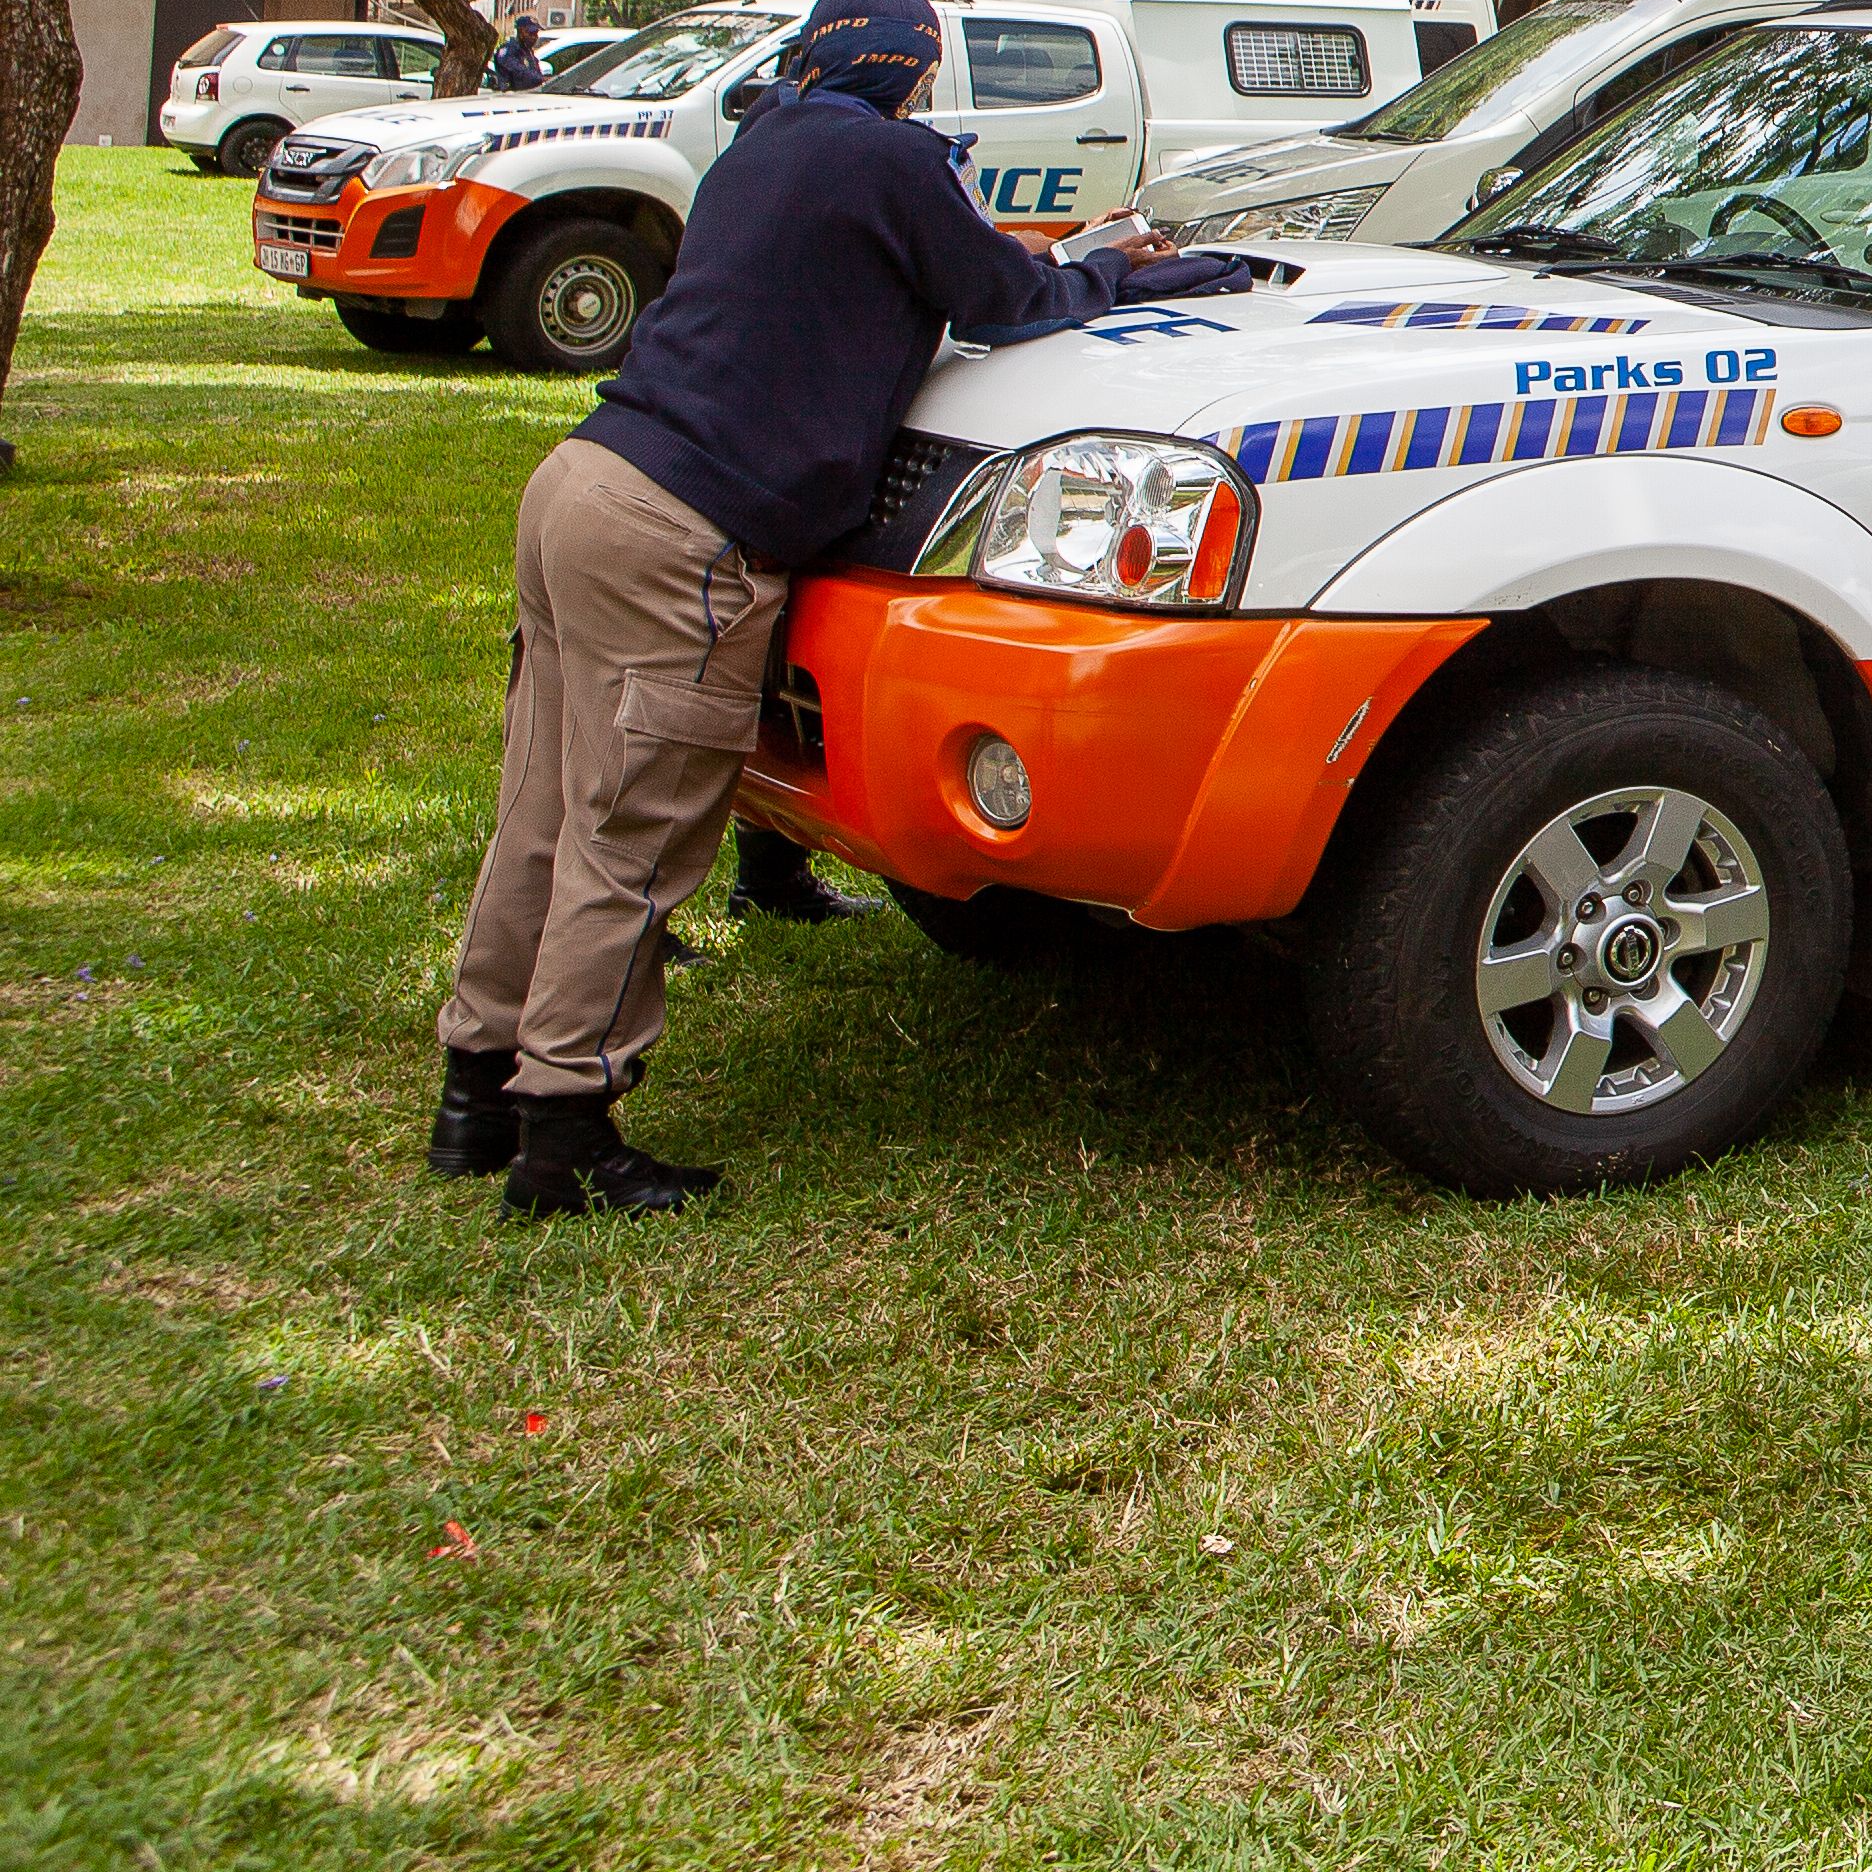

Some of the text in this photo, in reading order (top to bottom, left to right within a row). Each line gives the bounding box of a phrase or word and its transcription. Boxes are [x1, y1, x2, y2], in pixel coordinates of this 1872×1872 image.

[851, 53, 920, 67] JMPD
[978, 167, 1083, 214] ICE
[1515, 348, 1778, 394] Parks 02
